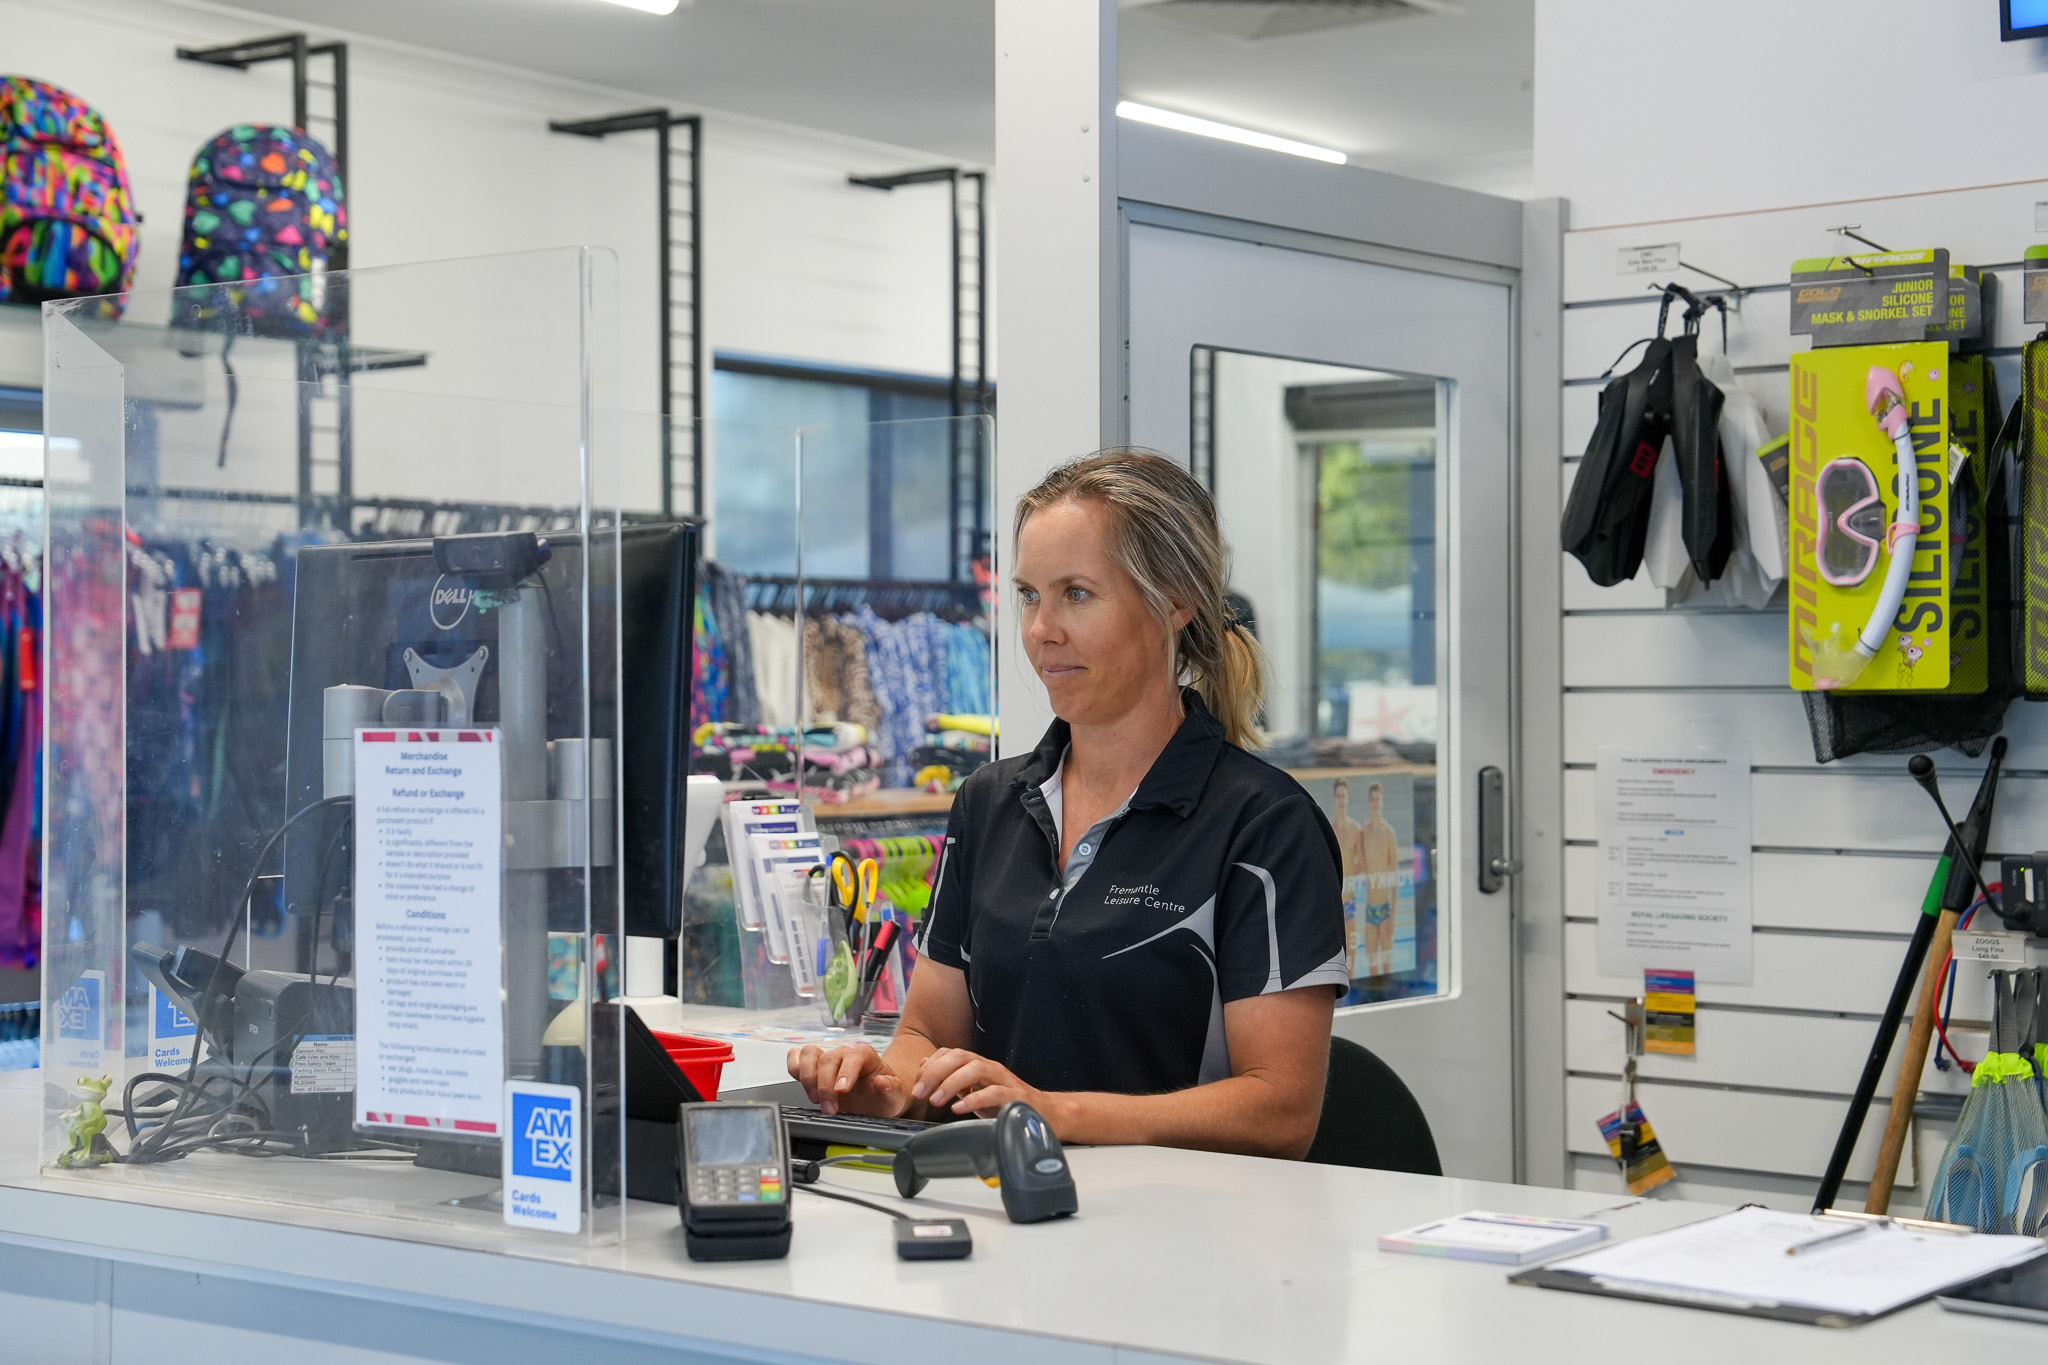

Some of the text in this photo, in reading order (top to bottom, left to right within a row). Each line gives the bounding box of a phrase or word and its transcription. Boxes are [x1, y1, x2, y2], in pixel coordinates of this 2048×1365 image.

[1892, 279, 1933, 294] JUNIOR
[1882, 292, 1933, 307] SILICONE
[1811, 311, 1844, 325] MASK
[1846, 310, 1855, 322] &
[1858, 307, 1908, 322] SNORKEL
[1912, 304, 1933, 317] SET
[1793, 363, 1818, 677] MIRAGE
[434, 588, 466, 605] DELL
[400, 752, 448, 760] Merchandise
[385, 766, 462, 778] Return and Exchange
[392, 788, 418, 797] Refund
[430, 788, 465, 800] Exchange
[418, 807, 444, 815] exchange
[1109, 884, 1160, 896] Fremantle
[1104, 896, 1186, 913] Leisure Centre
[406, 909, 446, 919] Conditions
[1631, 911, 1728, 922] ROYAL LIFESAVING SOCIETY
[425, 926, 450, 934] exchange
[155, 1048, 180, 1058] Cards
[155, 1056, 194, 1068] Welcome
[527, 1107, 572, 1138] AM
[512, 1190, 542, 1204] Cards
[512, 1204, 558, 1220] Welcome
